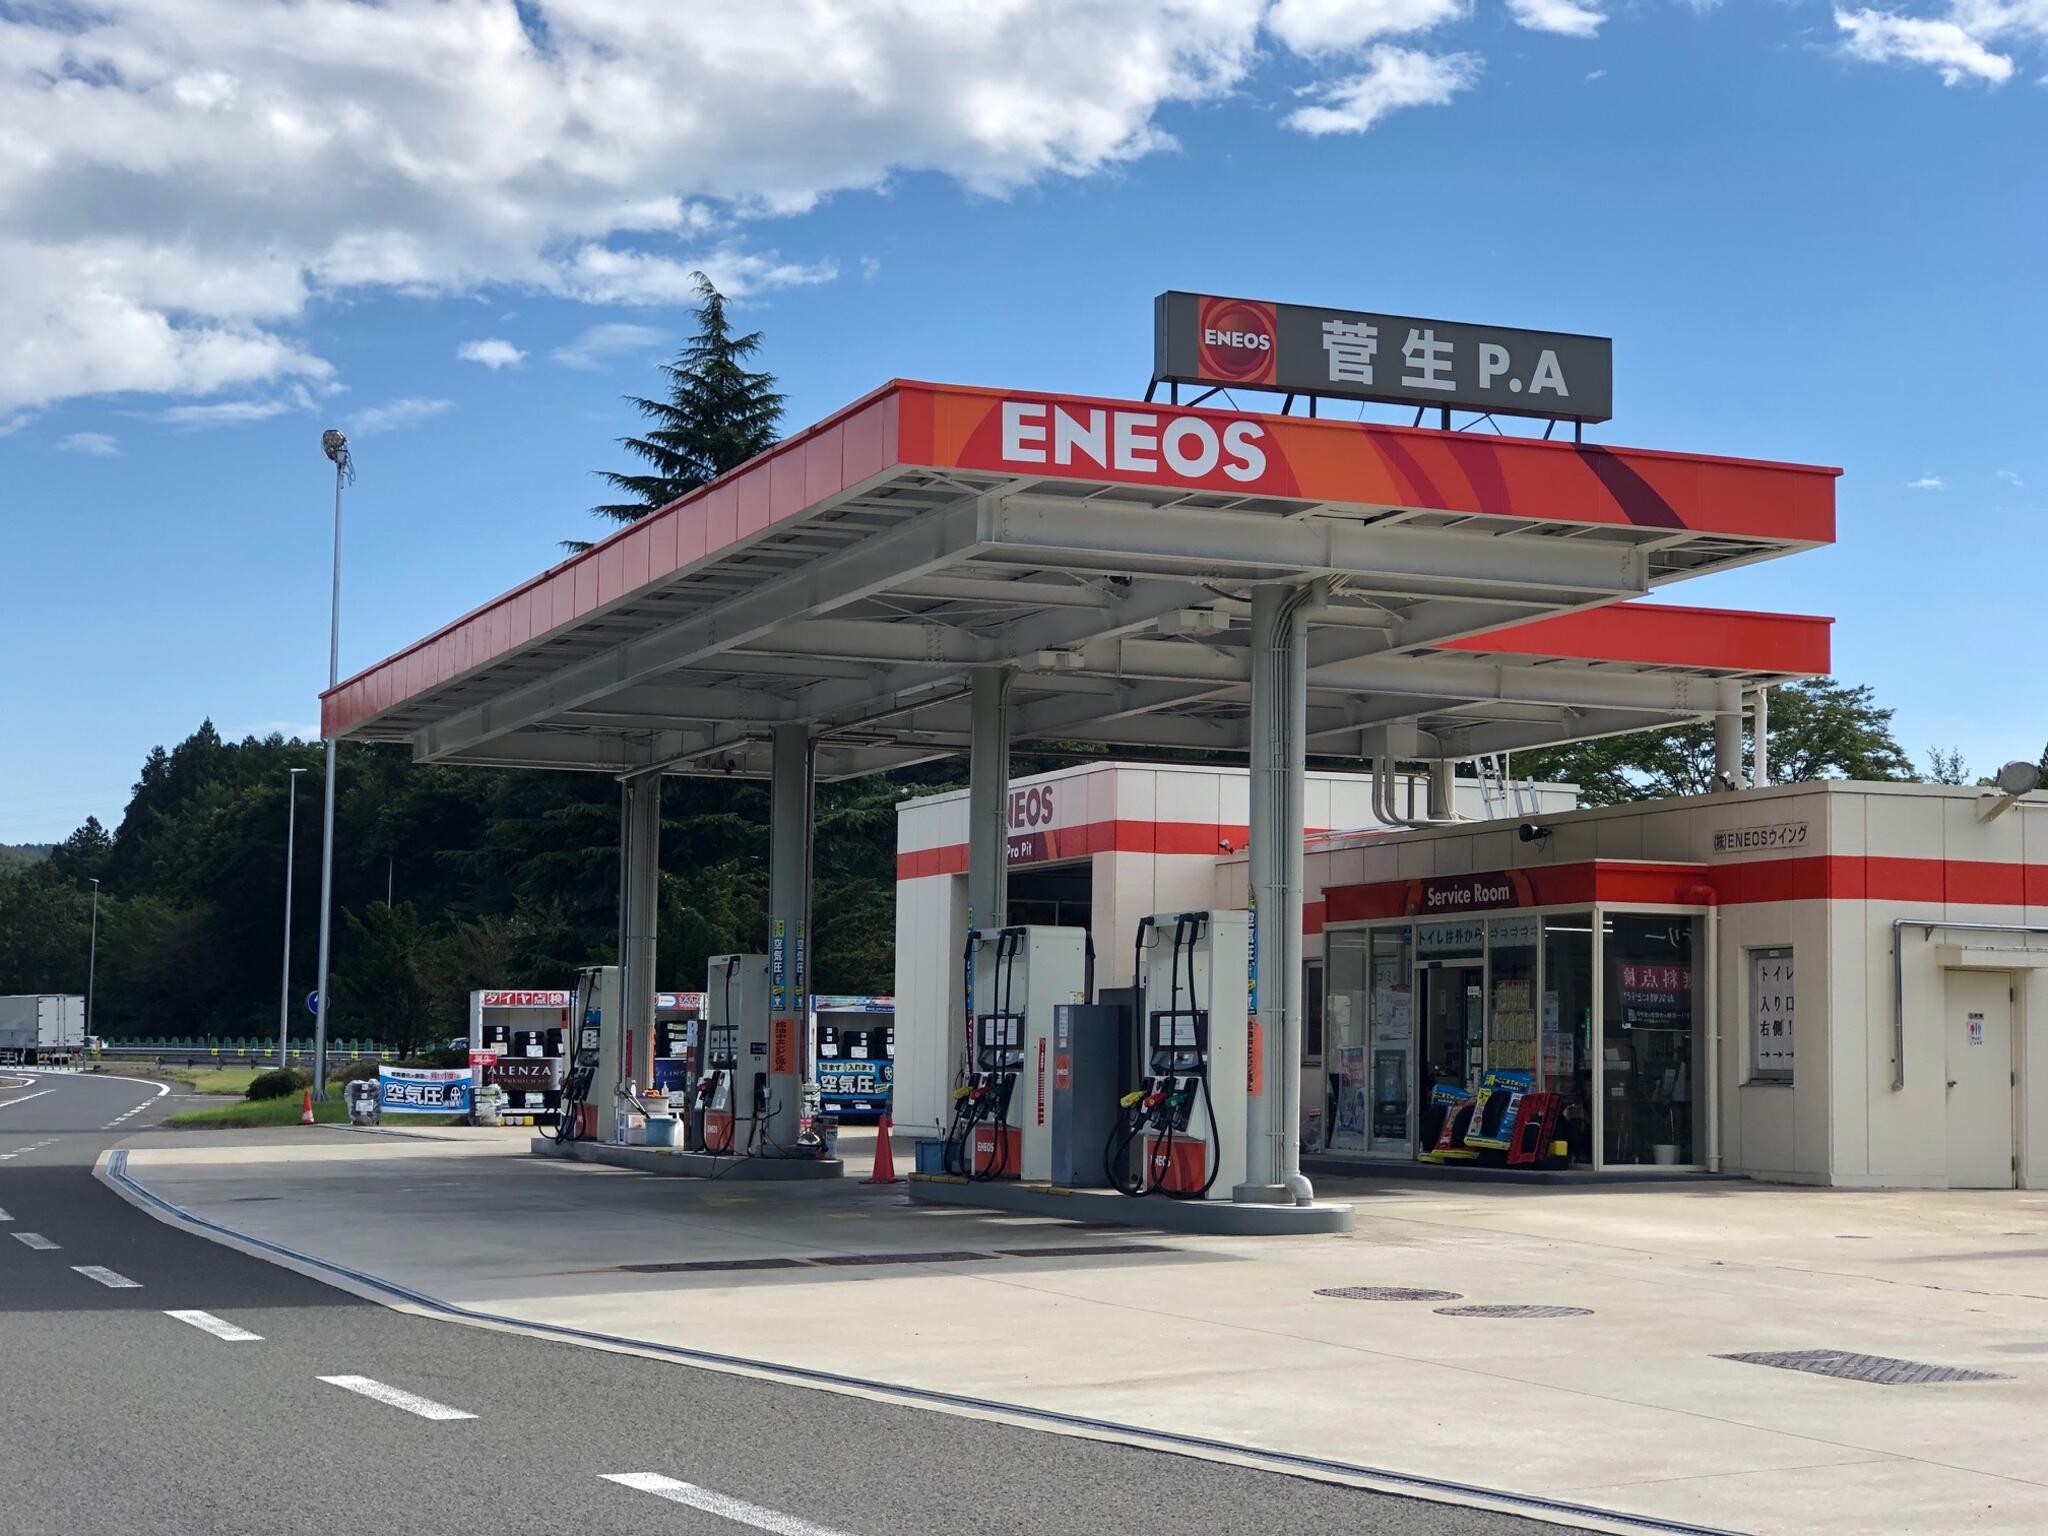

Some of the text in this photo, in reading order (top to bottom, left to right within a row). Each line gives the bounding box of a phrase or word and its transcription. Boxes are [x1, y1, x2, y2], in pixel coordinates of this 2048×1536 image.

[1205, 328, 1271, 351] ENEOS
[1322, 319, 1570, 397] 菅生 P.A
[1001, 400, 1267, 482] ENEOS
[1021, 840, 1032, 857] Pit
[1427, 883, 1510, 906] Service Room
[1418, 927, 1483, 945] トイレは外から
[1762, 965, 1794, 982] トイレ
[486, 993, 563, 1005] タイヤ点検
[1761, 996, 1794, 1012] 入り口
[487, 1066, 552, 1076] ALENZA
[820, 1075, 874, 1094] 空気圧
[385, 1084, 443, 1105] 空気圧
